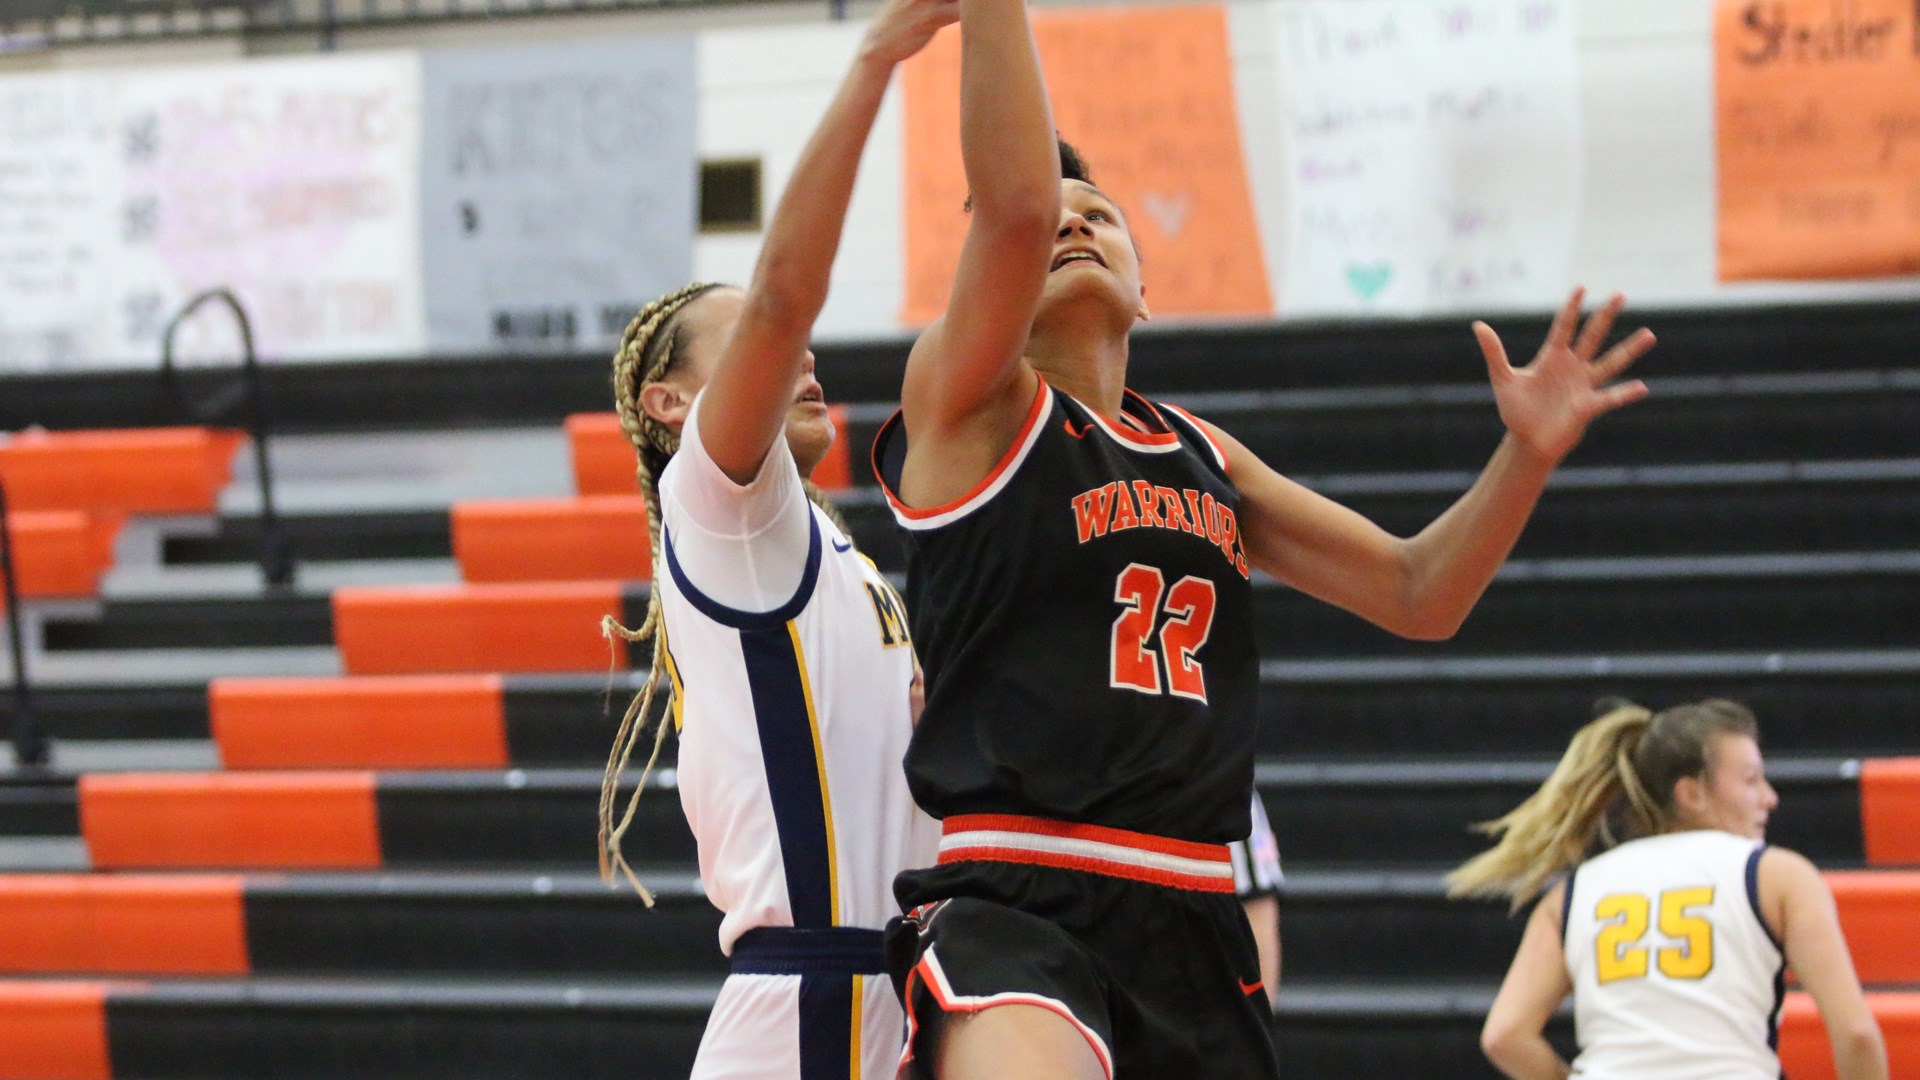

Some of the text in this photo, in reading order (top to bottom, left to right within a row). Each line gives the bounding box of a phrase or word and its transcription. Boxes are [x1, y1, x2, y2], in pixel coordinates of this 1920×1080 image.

[1071, 479, 1250, 580] WARRIORS
[1109, 562, 1217, 706] 22
[1594, 885, 1716, 985] 25
